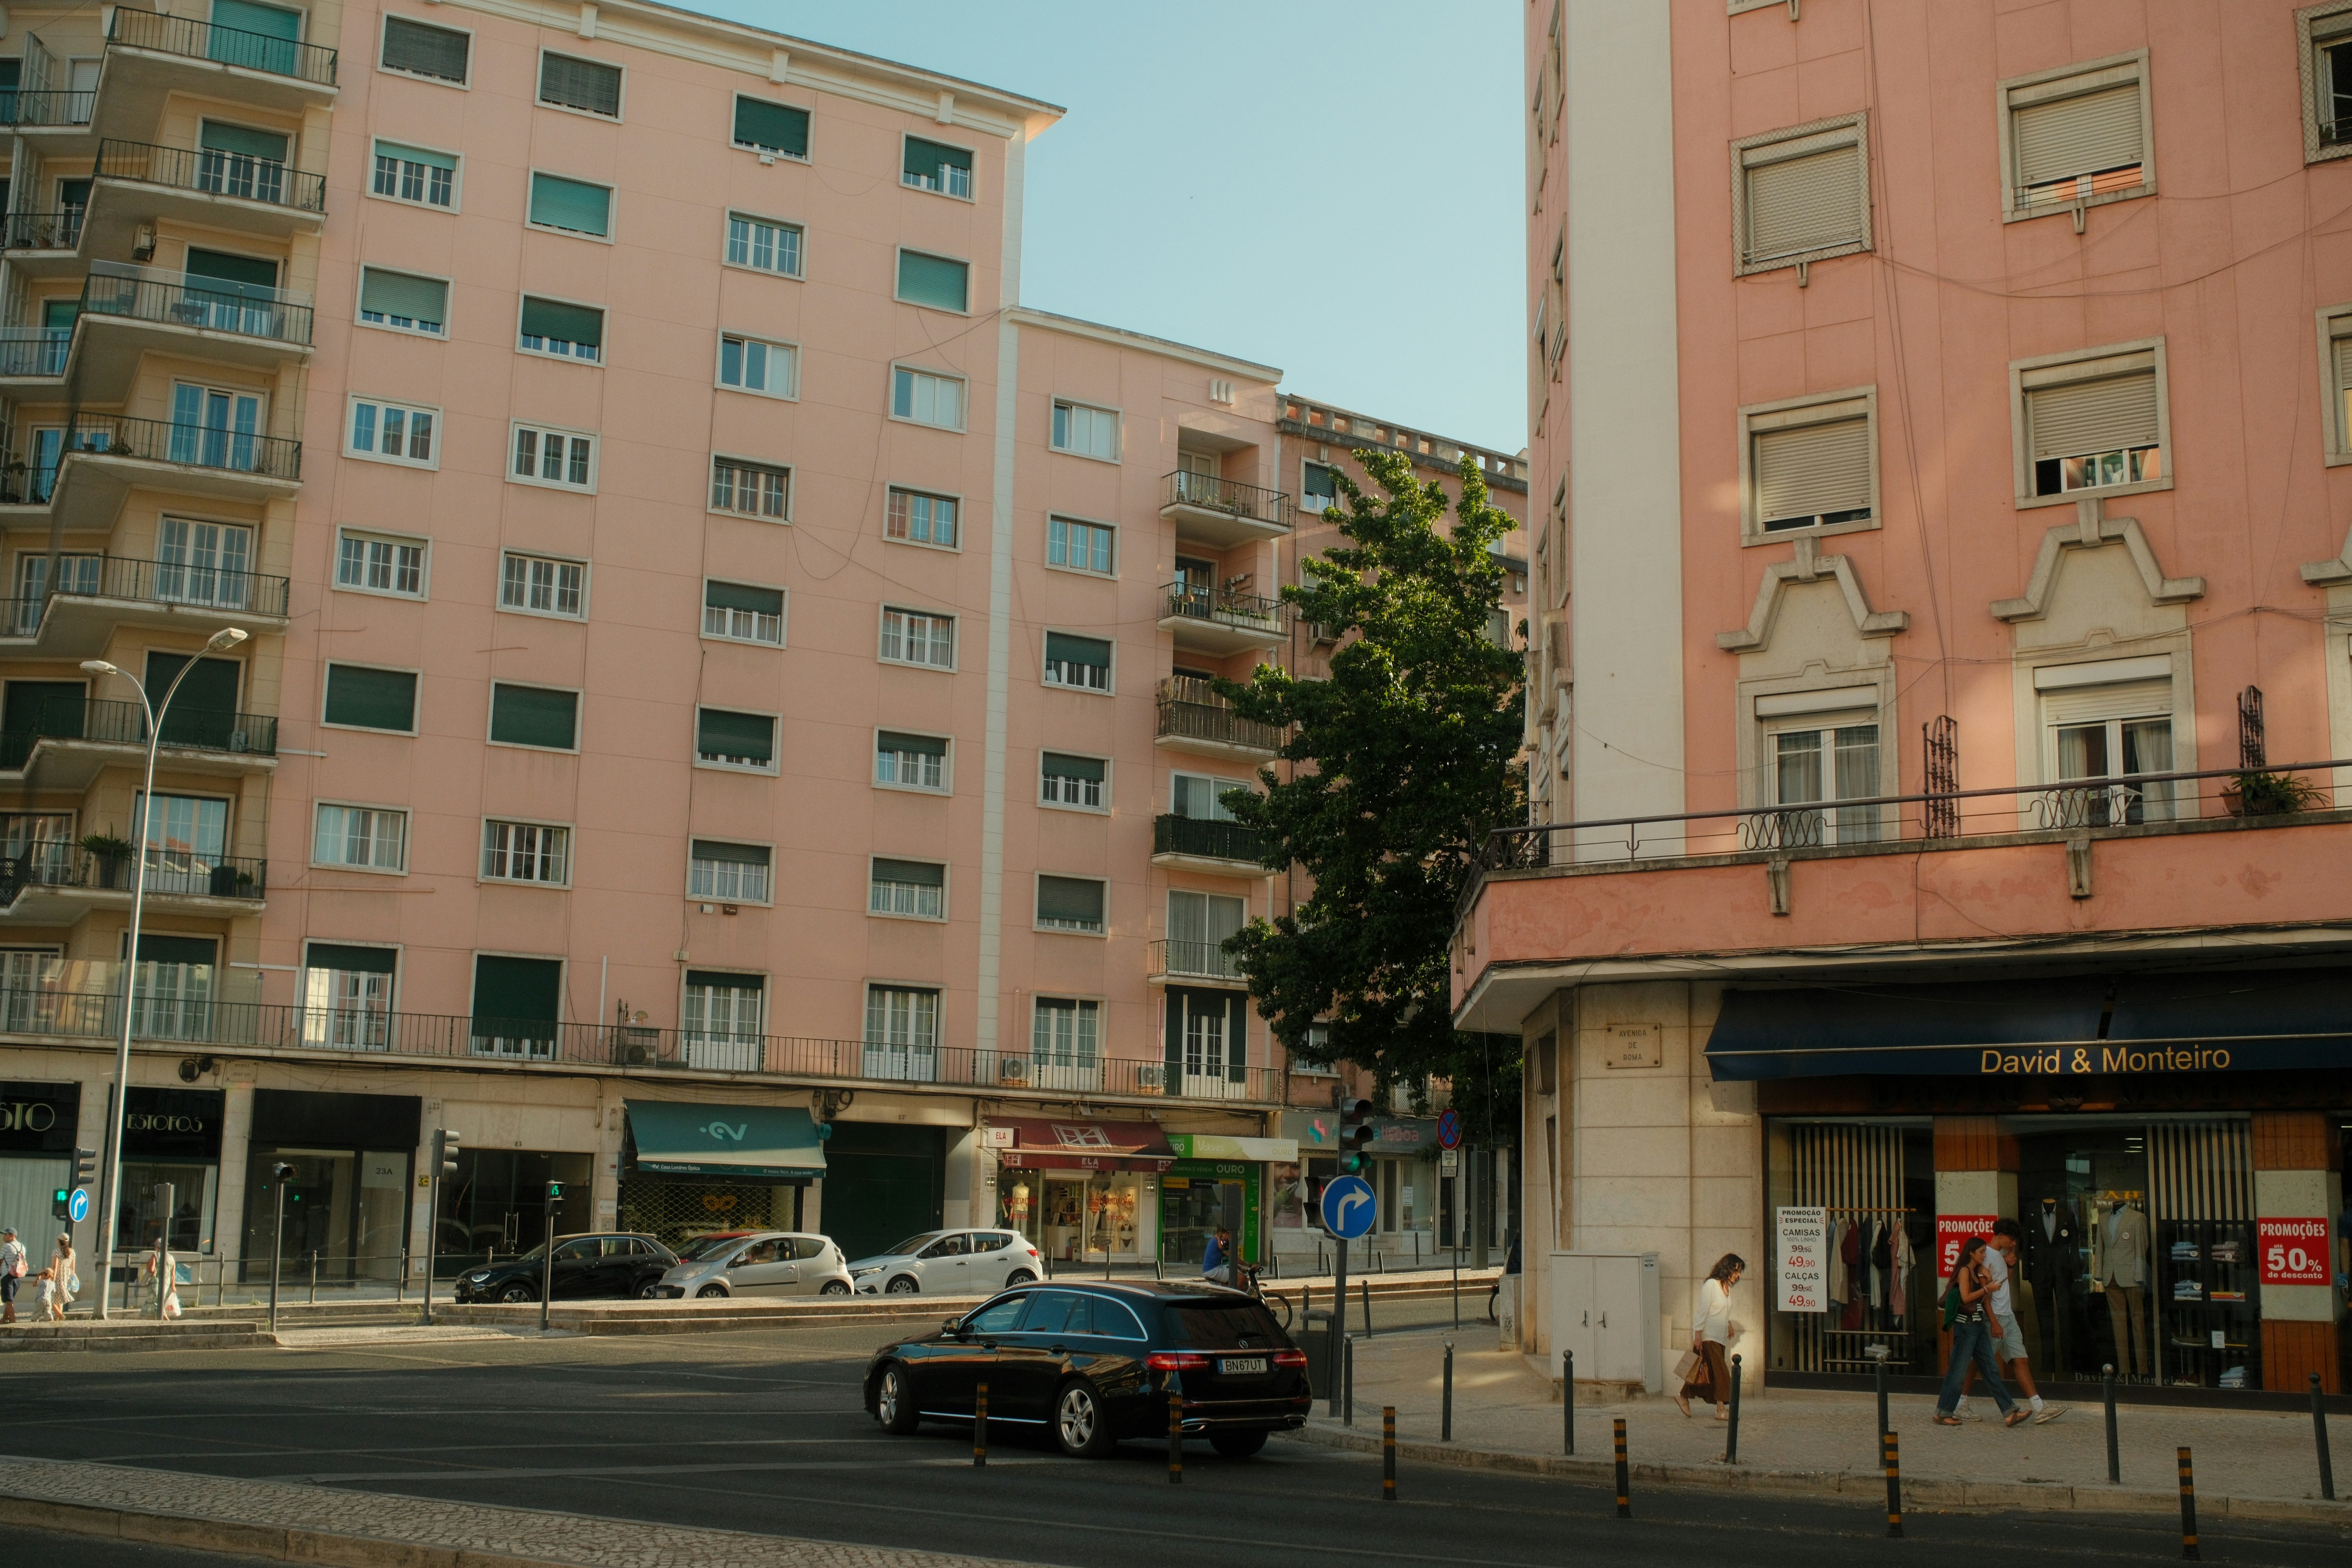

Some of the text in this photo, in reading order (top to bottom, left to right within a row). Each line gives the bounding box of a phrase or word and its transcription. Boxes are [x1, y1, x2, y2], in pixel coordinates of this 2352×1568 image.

[1981, 1044, 2230, 1073] David & Monteiro
[127, 1114, 202, 1132] ESTOFOS
[1197, 1140, 1225, 1152] Valores
[1216, 1164, 1245, 1174] OURO
[57, 1191, 66, 1200] 15
[551, 1185, 559, 1195] 15
[1939, 1218, 1994, 1236] PROMOÇÕES
[2260, 1220, 2325, 1240] PROMOÇÕES
[1792, 1245, 1811, 1253] 99,90
[1788, 1256, 1815, 1268] 49,90
[2267, 1248, 2322, 1272] 50%
[1785, 1272, 1819, 1281] CALÇAS
[1792, 1284, 1812, 1292] 99,90
[1788, 1295, 1816, 1308] 49,90
[2075, 1372, 2102, 1382] Davi
[2115, 1373, 2125, 1383] &
